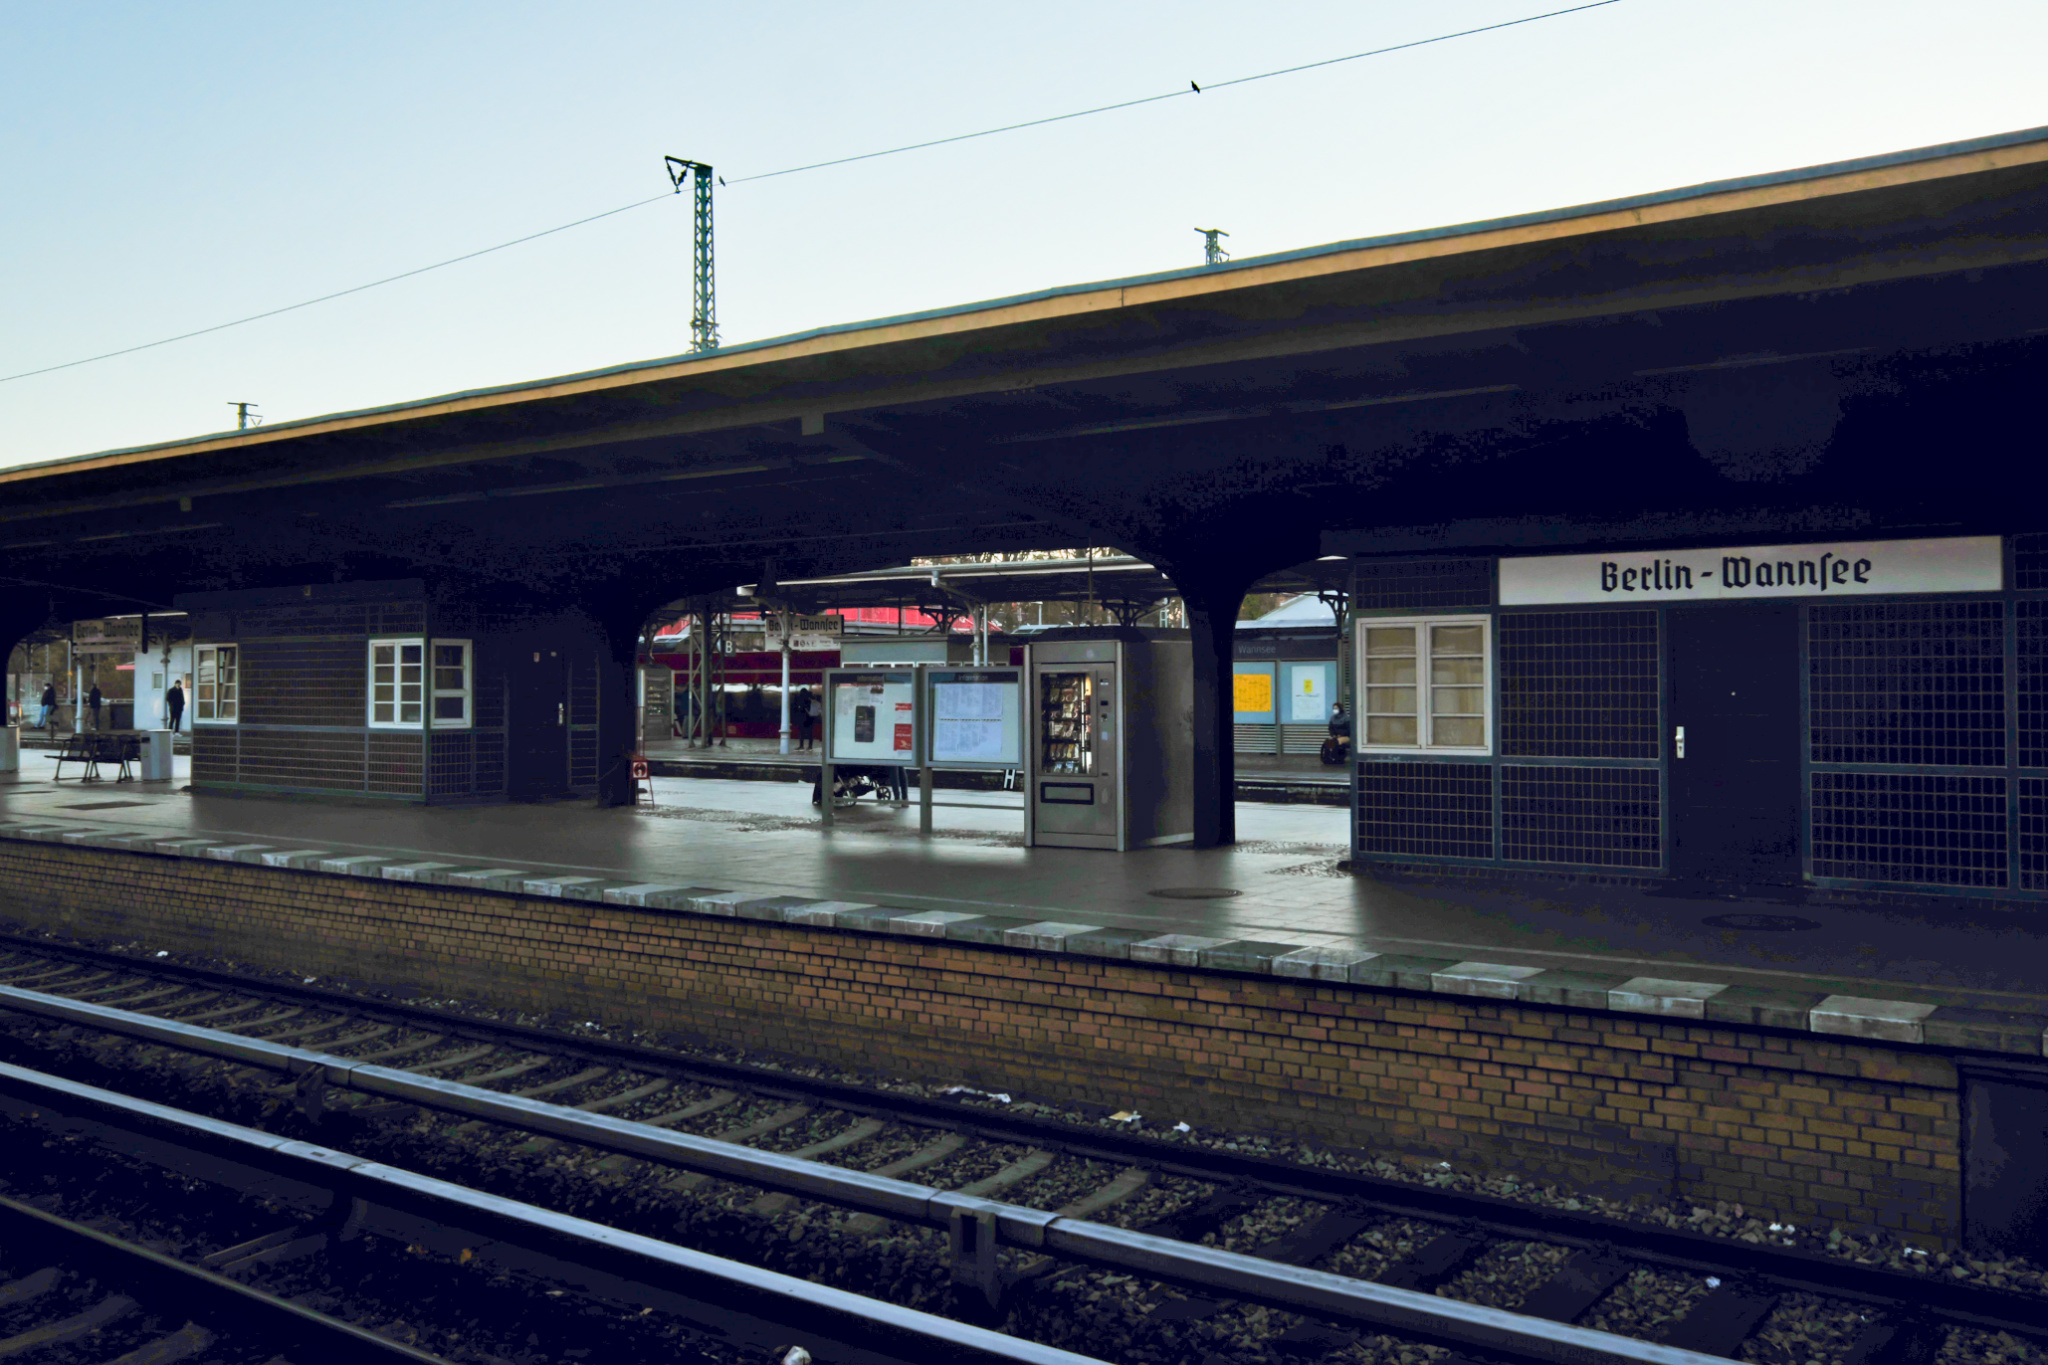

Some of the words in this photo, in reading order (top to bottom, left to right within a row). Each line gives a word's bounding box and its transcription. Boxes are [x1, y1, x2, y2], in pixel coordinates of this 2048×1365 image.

[1601, 558, 1694, 593] Berlin
[725, 640, 733, 653] B
[1238, 645, 1277, 654] Wannsee
[1003, 769, 1015, 789] H
